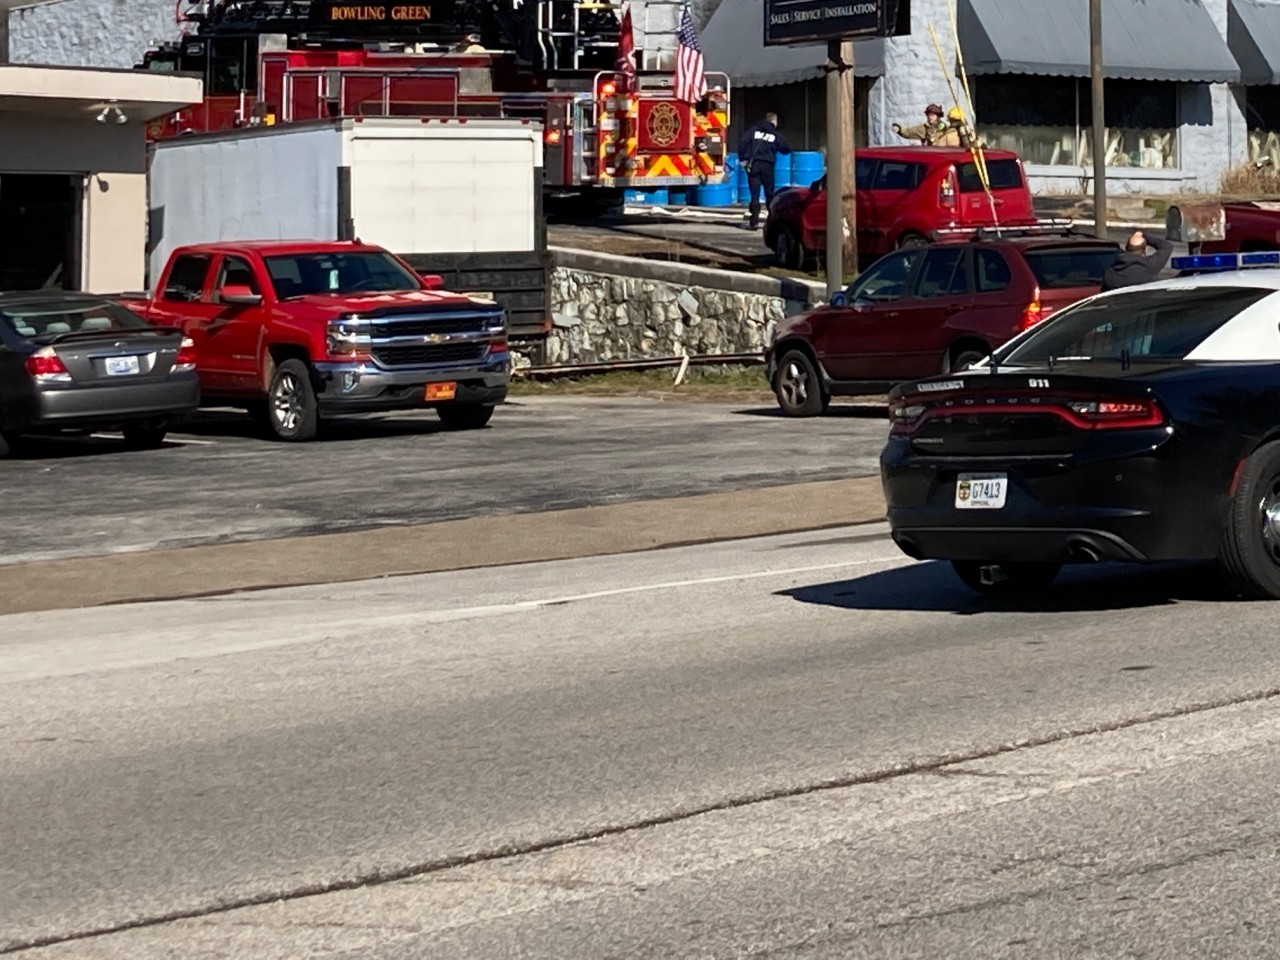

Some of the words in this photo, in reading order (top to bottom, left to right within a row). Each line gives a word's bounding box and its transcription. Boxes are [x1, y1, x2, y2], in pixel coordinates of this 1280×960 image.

[331, 6, 386, 20] BOWLING
[391, 6, 431, 20] GREEN
[771, 14, 790, 24] SALES
[795, 10, 821, 22] SERVICE
[825, 3, 876, 18] INSTALLATION
[972, 482, 1001, 499] G7413
